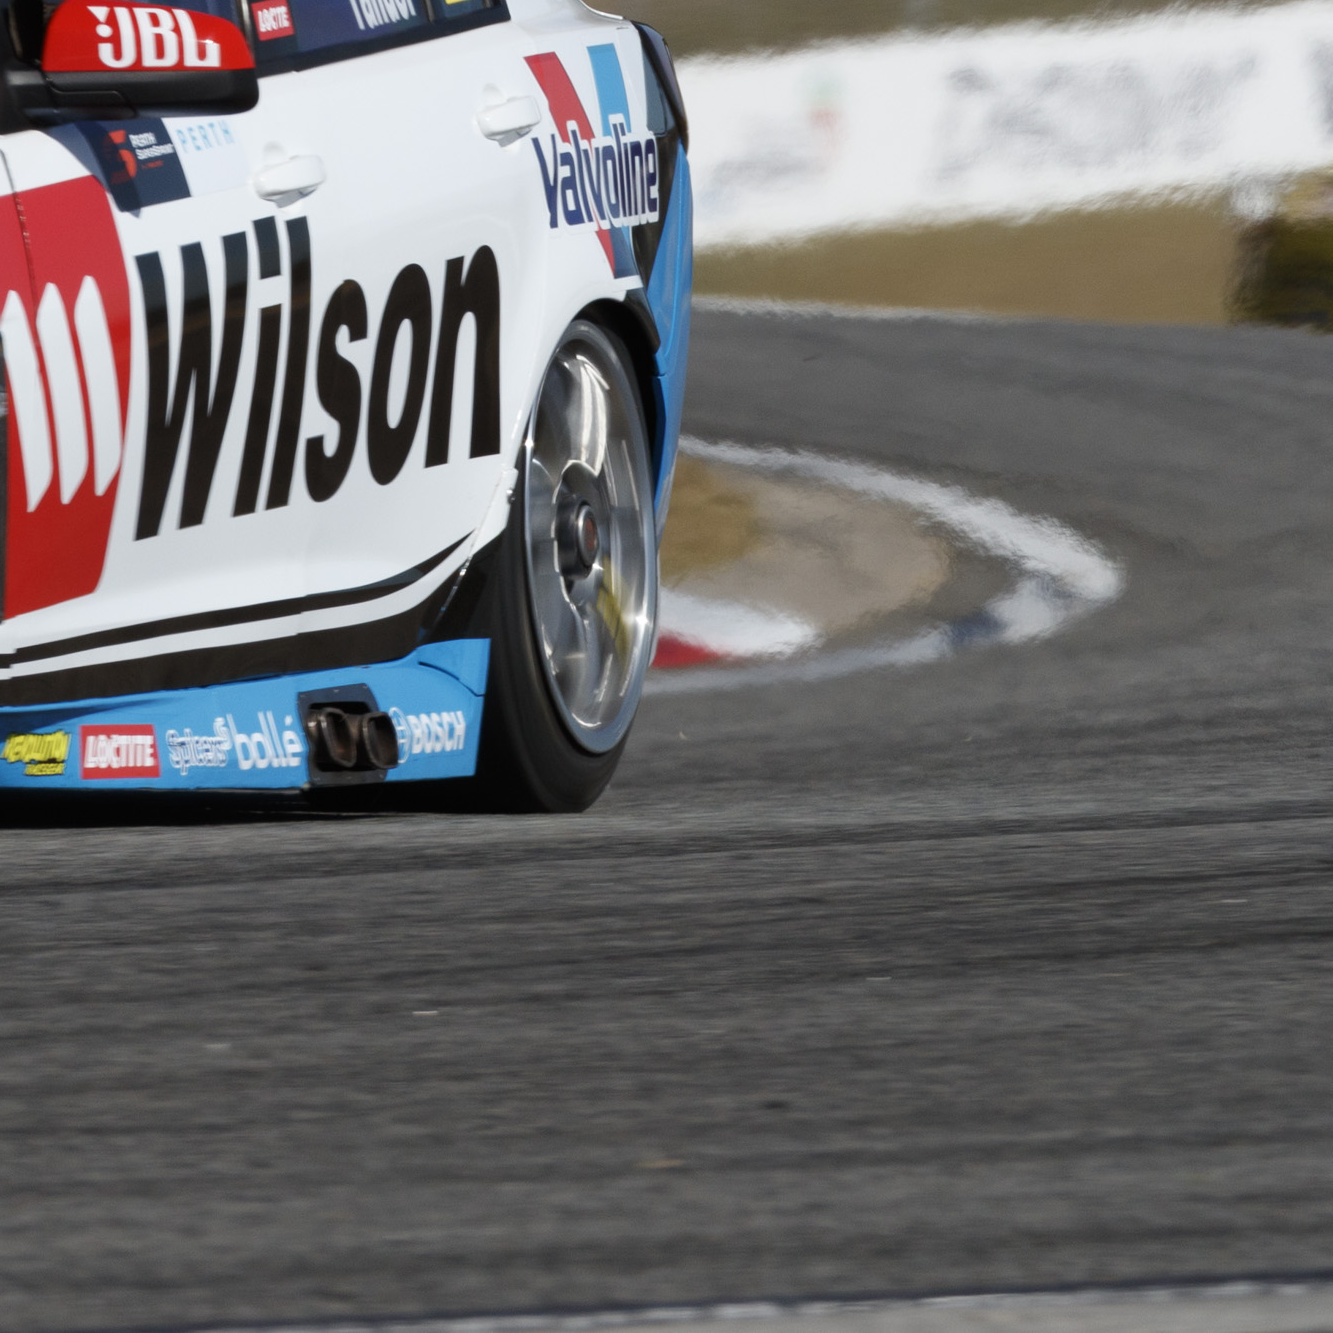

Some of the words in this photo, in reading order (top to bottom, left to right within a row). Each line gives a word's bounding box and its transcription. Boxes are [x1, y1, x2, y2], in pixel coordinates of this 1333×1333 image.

[91, 6, 221, 68] JBL
[533, 121, 662, 229] Valvoline
[133, 216, 501, 541] Wilson
[84, 735, 155, 768] LOCTITE
[406, 711, 467, 753] BOSCH
